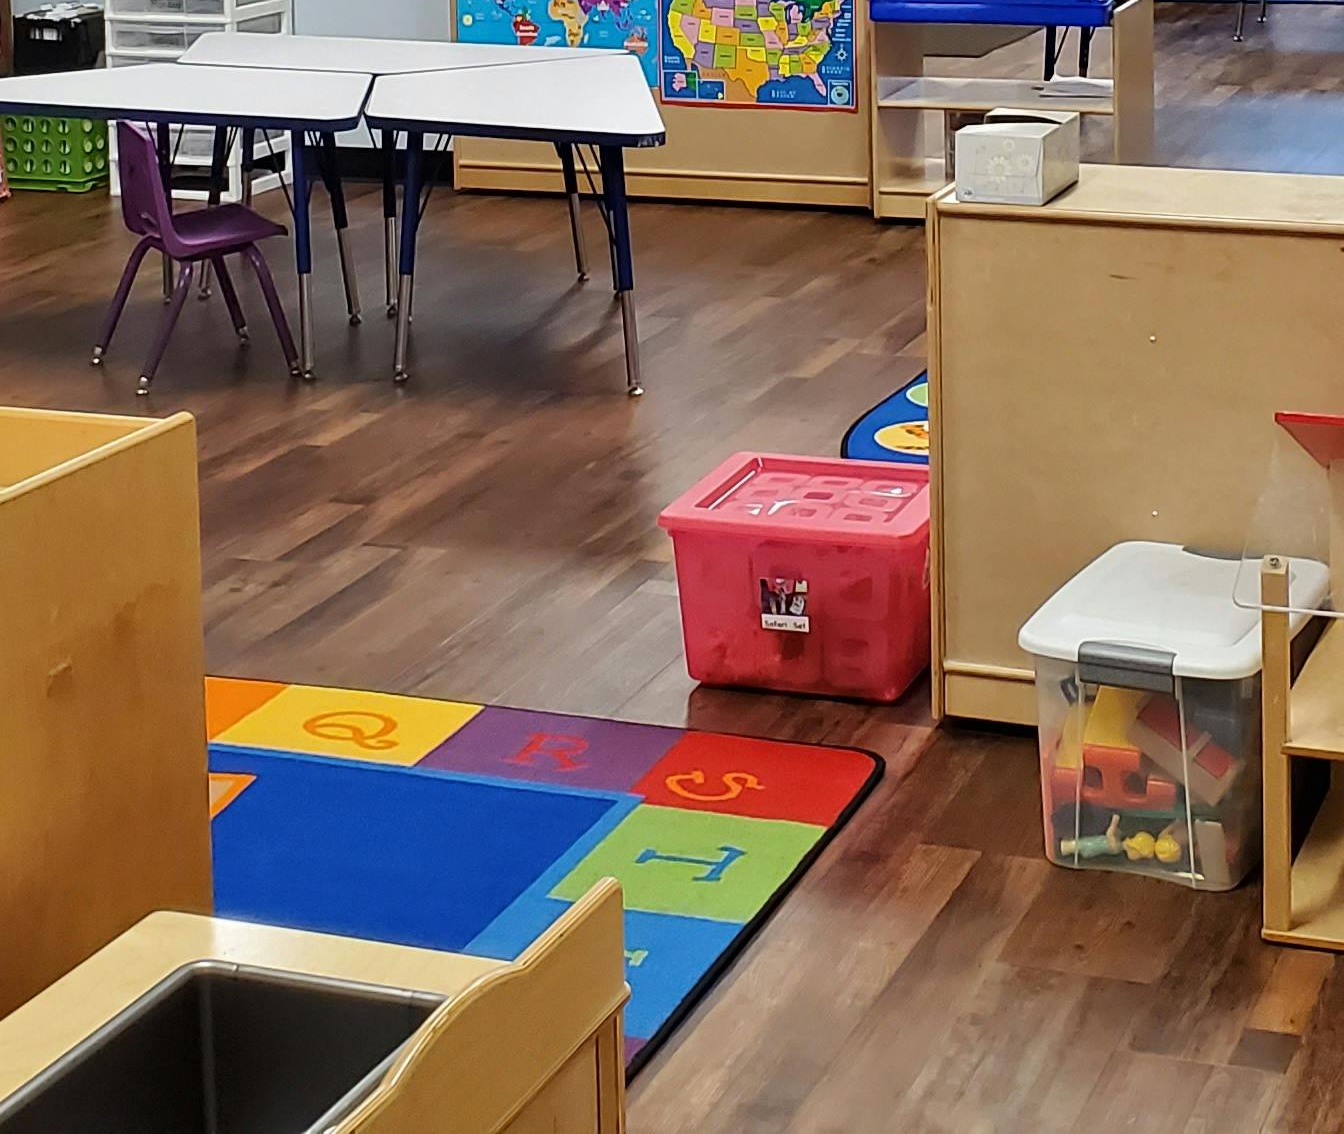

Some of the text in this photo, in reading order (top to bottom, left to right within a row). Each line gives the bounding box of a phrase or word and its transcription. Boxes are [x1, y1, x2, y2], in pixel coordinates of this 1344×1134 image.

[301, 710, 399, 751] Q
[509, 731, 588, 772] R
[635, 845, 747, 882] T
